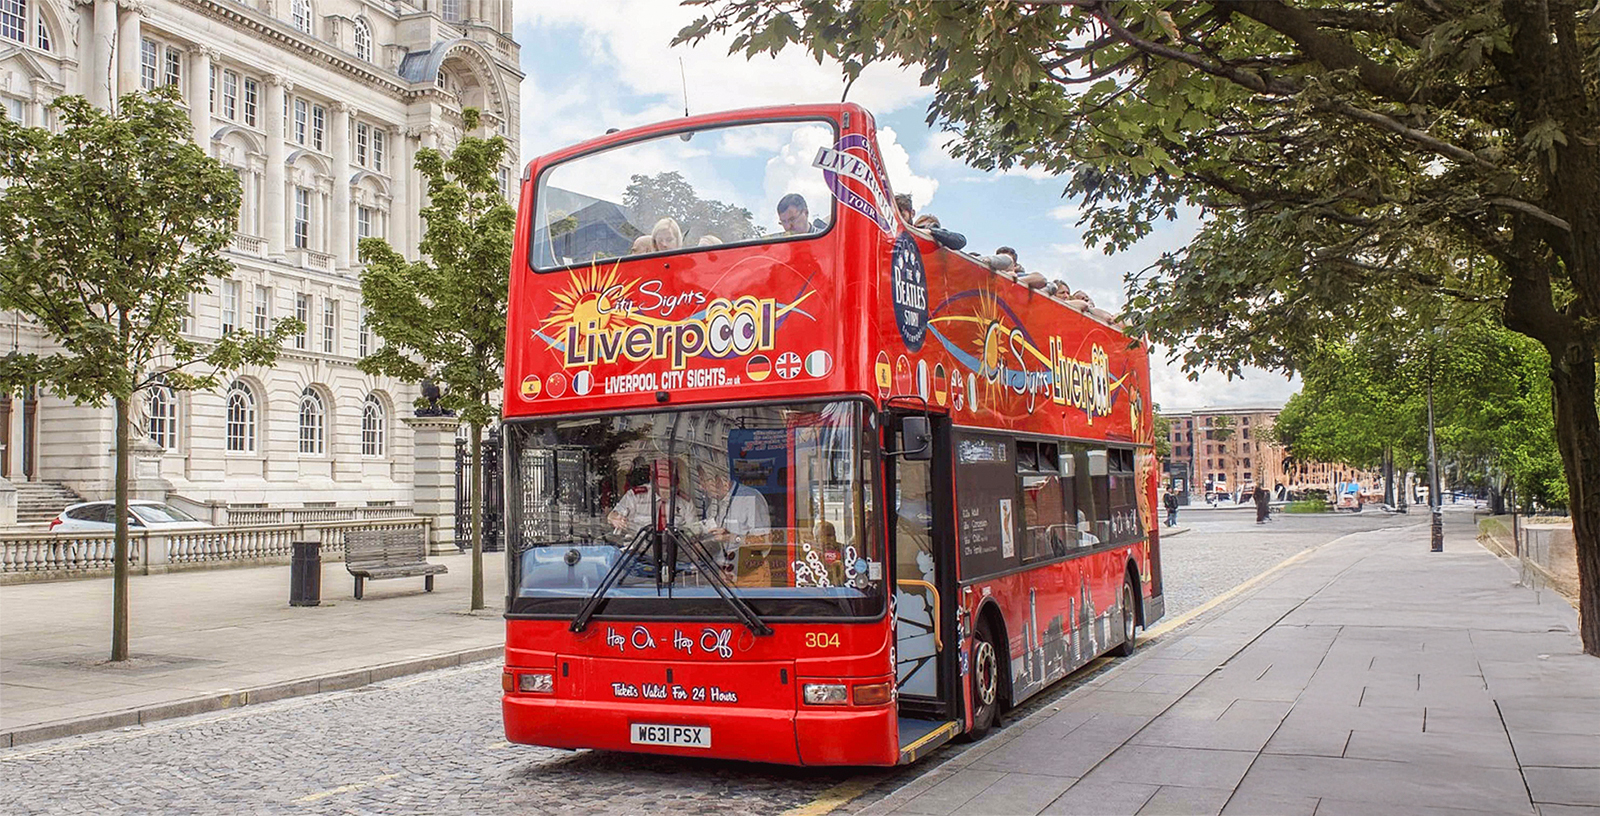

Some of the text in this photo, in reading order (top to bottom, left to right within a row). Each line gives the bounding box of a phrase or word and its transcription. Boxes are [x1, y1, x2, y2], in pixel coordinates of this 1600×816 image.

[818, 150, 897, 232] LIVERPOOL
[849, 194, 876, 218] TOUR
[597, 280, 706, 317] City Sights
[894, 265, 926, 311] BEATLES
[566, 295, 777, 370] Liverpool
[604, 372, 658, 394] LIVERPOOL
[661, 370, 684, 390] CITY
[1048, 335, 1112, 426] Liverpool
[607, 626, 626, 652] Hop
[631, 625, 656, 649] On
[673, 628, 694, 655] Hop
[699, 627, 733, 658] Off
[805, 632, 841, 648] 304
[611, 682, 738, 703] Tickets Valid For 24 Hours
[638, 726, 702, 743] W631 PSX
